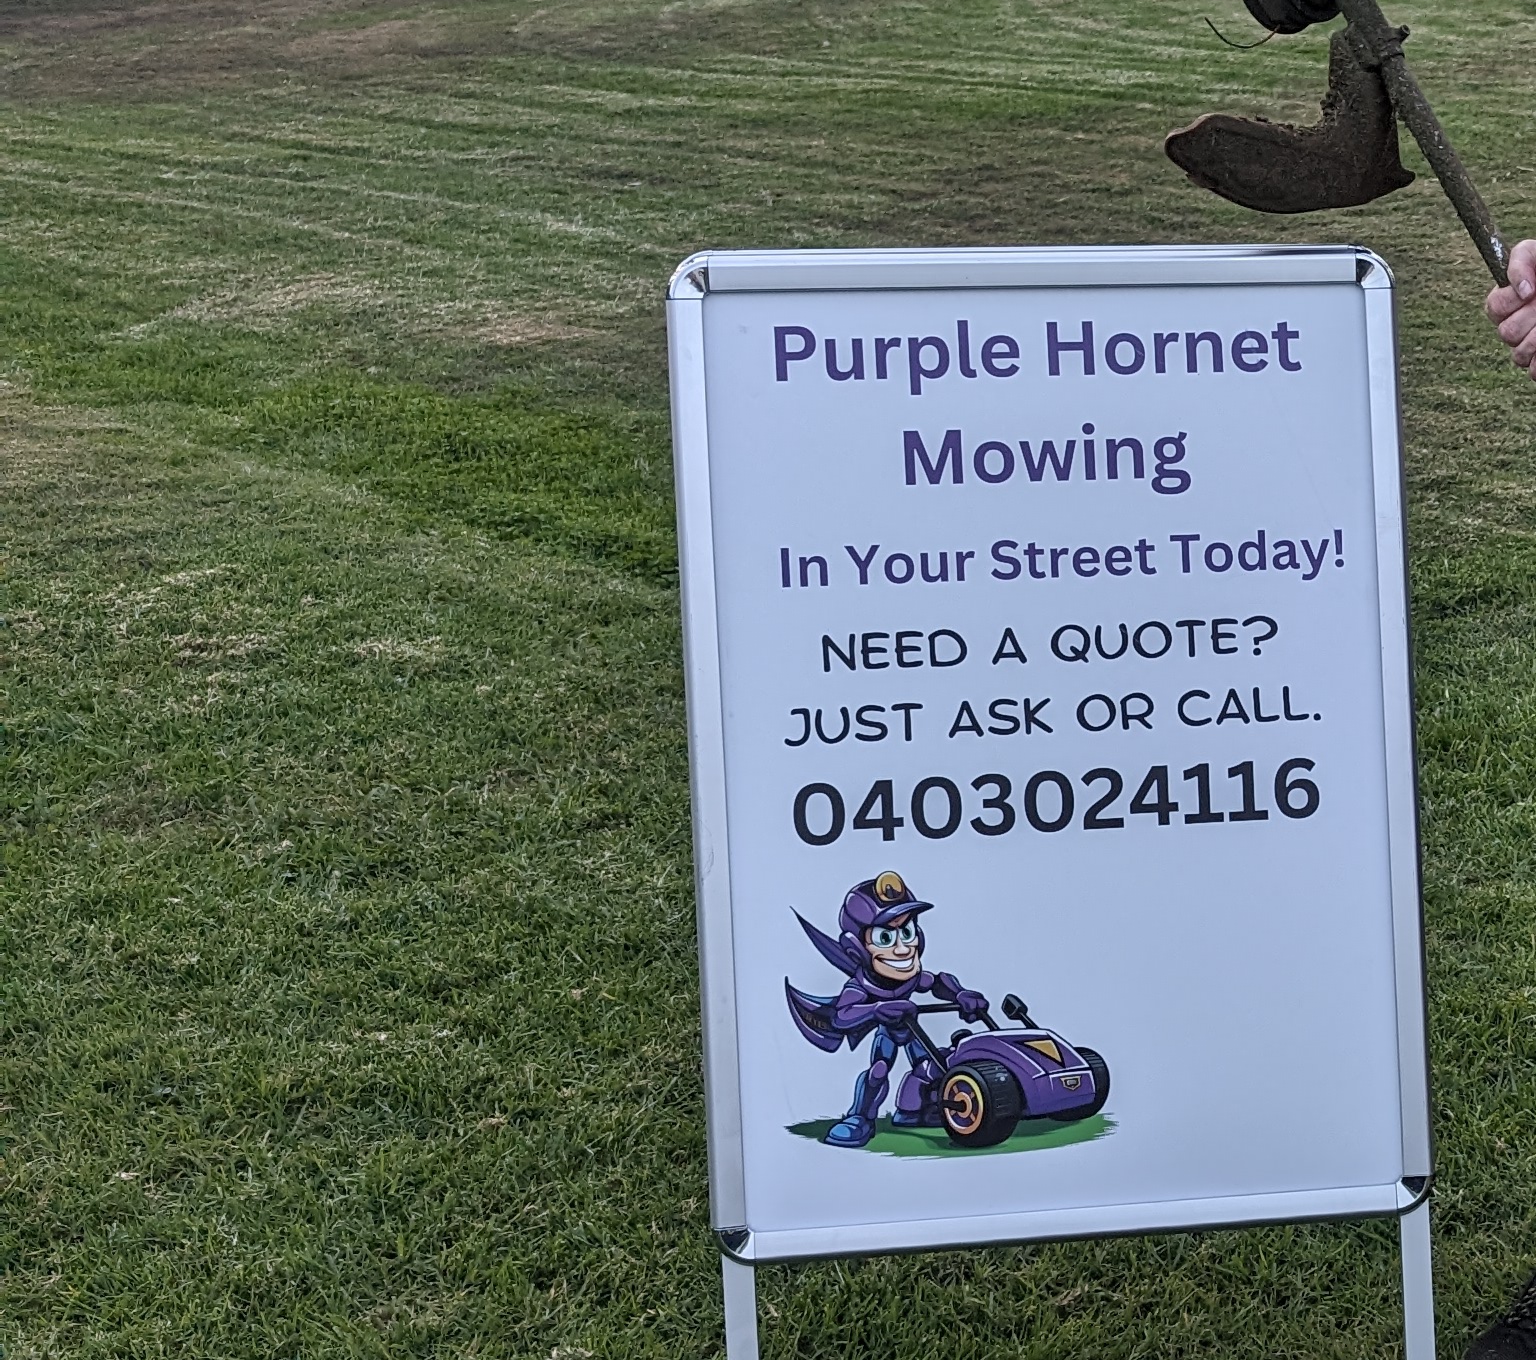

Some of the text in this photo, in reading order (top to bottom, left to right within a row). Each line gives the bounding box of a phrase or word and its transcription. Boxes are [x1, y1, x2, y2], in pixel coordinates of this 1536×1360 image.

[773, 319, 1303, 396] Purple Hornet
[902, 422, 1192, 495] Mowing
[780, 529, 1345, 588] In Your Street Today!
[821, 615, 1279, 673] NEED A QUOTE?
[783, 685, 1322, 747] JUST ASK OR CALL.
[793, 757, 1320, 847] 0403024116
